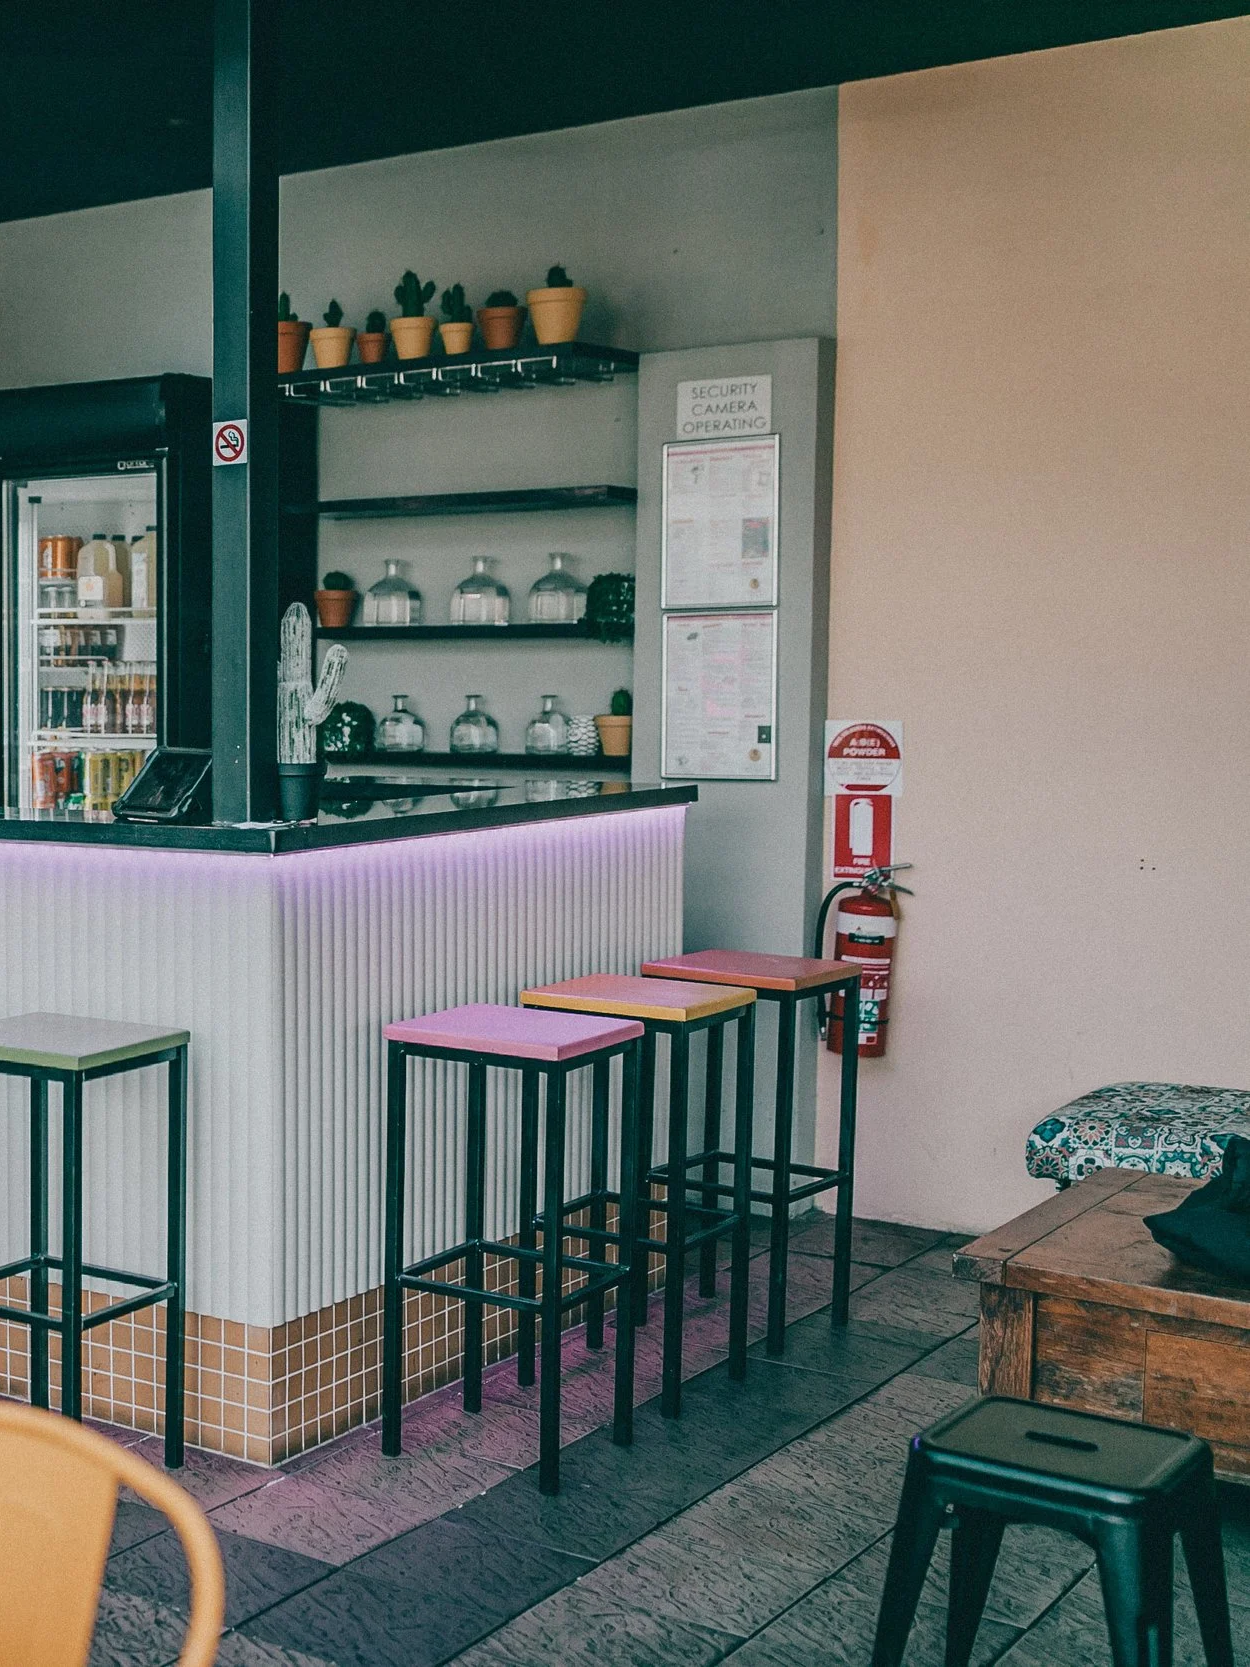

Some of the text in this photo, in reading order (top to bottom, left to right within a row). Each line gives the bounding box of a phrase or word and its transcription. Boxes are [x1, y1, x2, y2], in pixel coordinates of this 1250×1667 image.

[691, 382, 758, 399] SECURITY
[691, 400, 758, 416] CAMERA
[682, 416, 767, 434] OPERATING
[842, 747, 886, 757] POWDER
